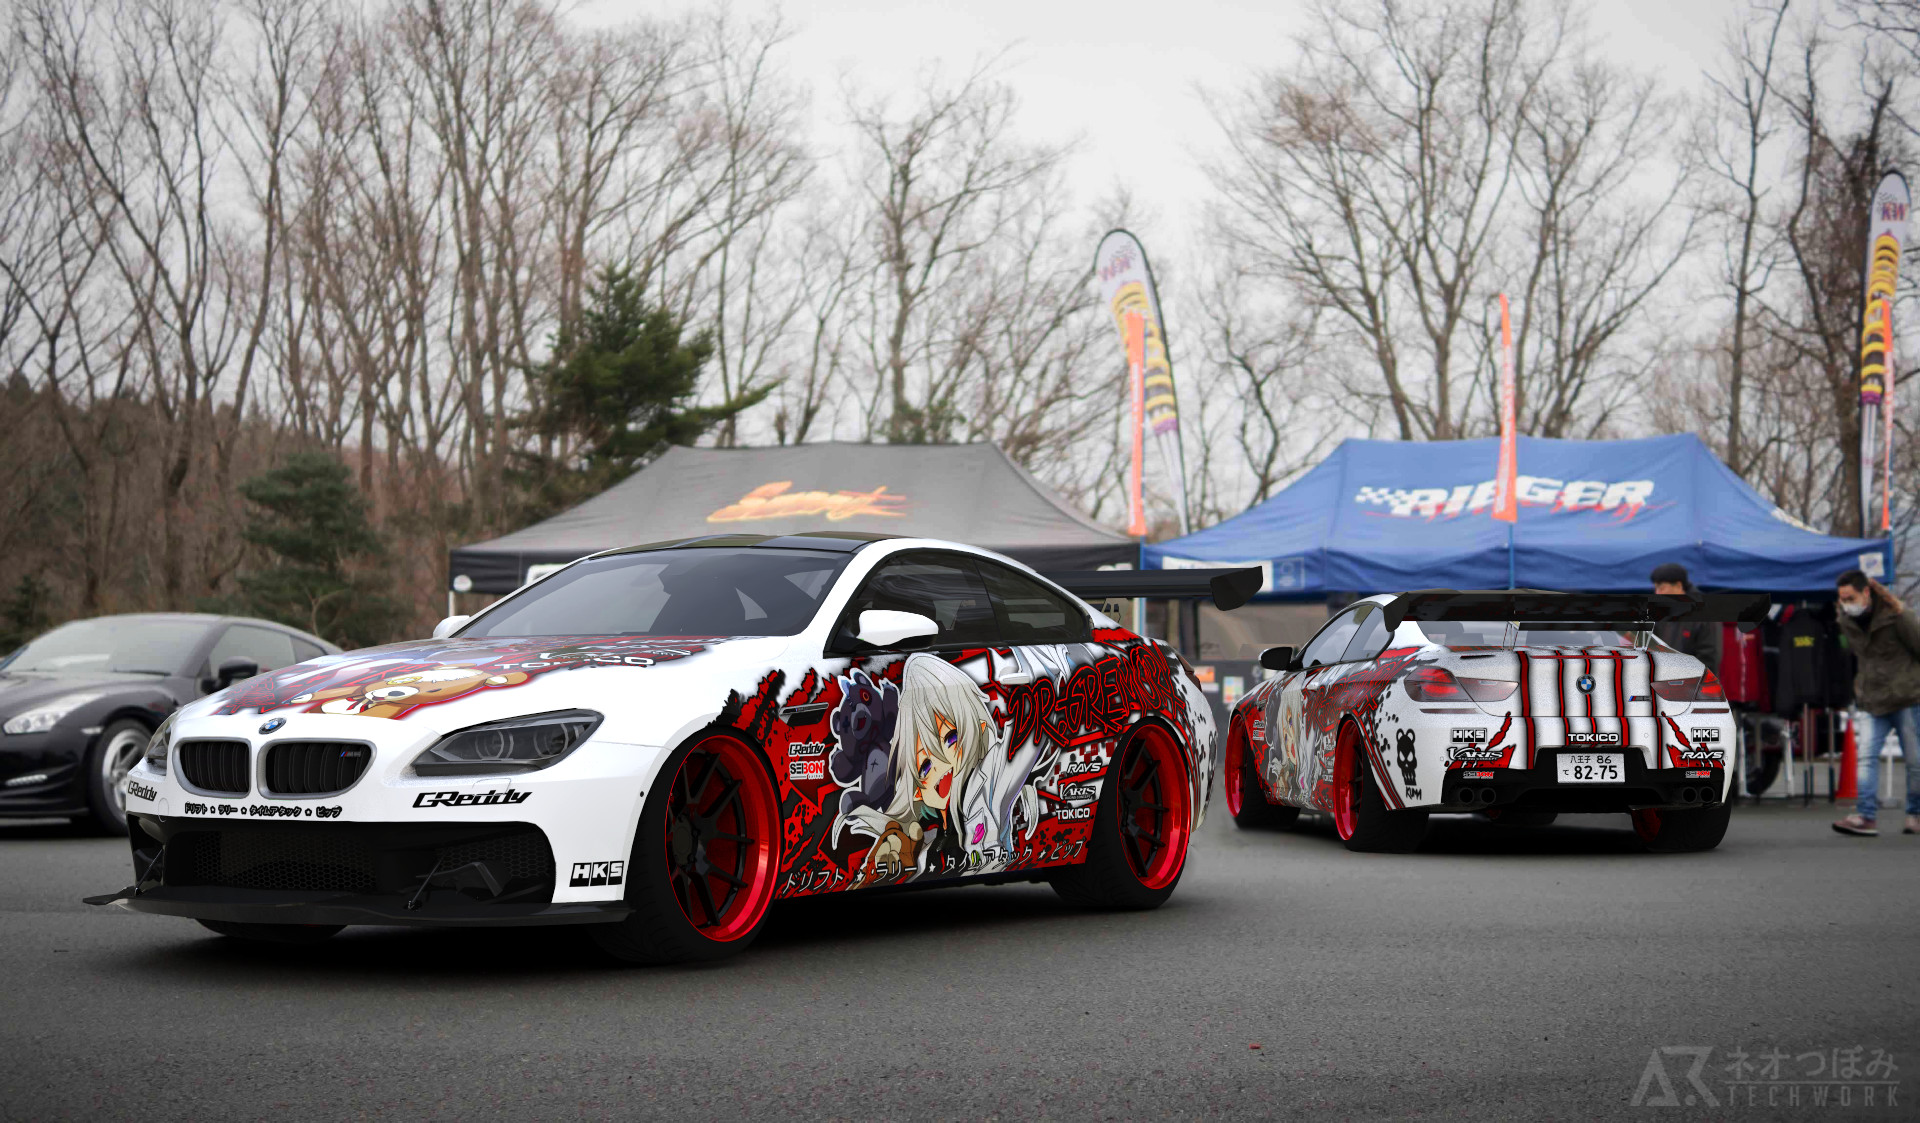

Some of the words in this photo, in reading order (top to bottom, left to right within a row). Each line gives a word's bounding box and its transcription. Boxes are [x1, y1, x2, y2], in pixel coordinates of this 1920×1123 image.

[1453, 730, 1486, 740] HKS
[1568, 733, 1619, 742] TOKICO
[1692, 729, 1719, 740] HKS
[1570, 755, 1591, 764] 八王子
[1596, 755, 1612, 764] 86
[1682, 751, 1724, 759] RAYS
[790, 762, 823, 775] SEIBON
[1067, 762, 1102, 773] RAYS
[1574, 765, 1618, 780] 82-75
[127, 780, 158, 802] GReddy
[412, 788, 533, 808] GReddy
[217, 804, 239, 815] ラリー
[1056, 807, 1091, 820] TOKICO
[570, 861, 624, 883] HKS
[782, 867, 844, 894] ドリフト
[873, 860, 918, 884] ラリー
